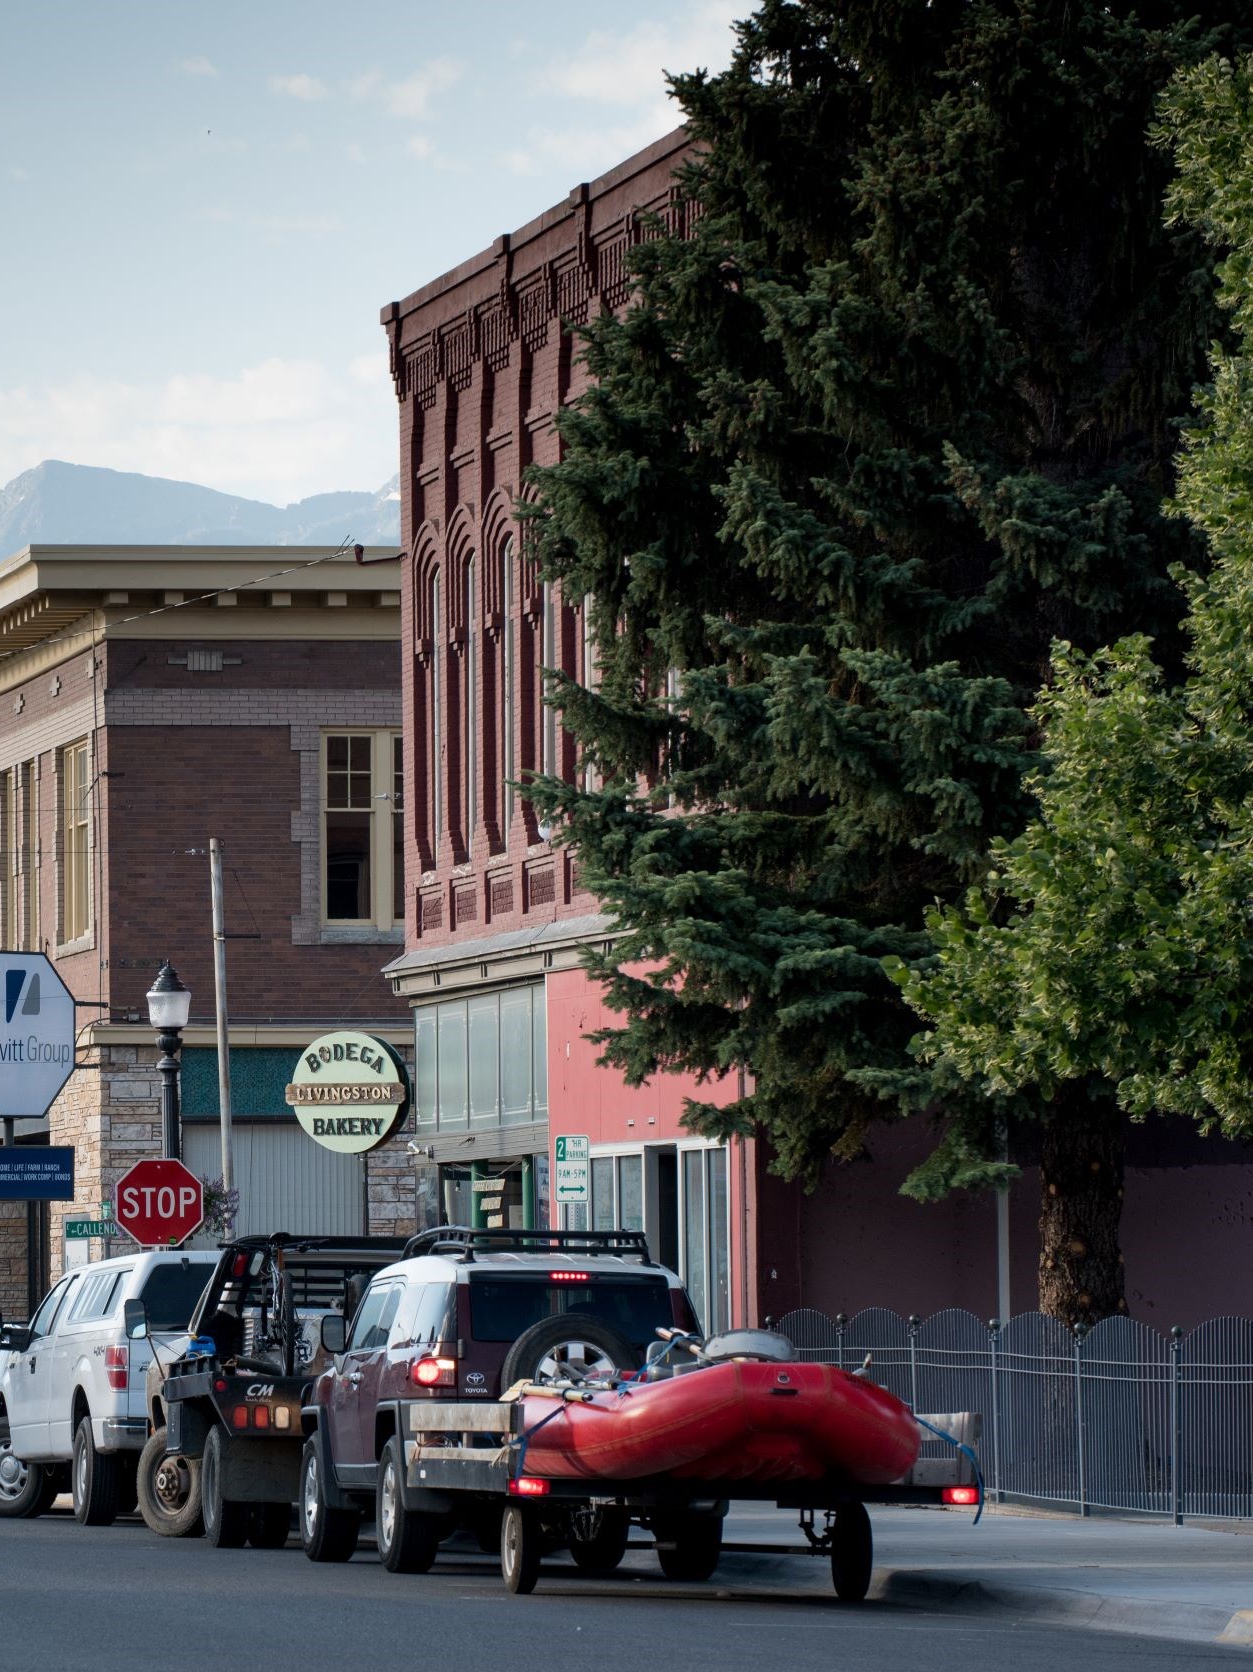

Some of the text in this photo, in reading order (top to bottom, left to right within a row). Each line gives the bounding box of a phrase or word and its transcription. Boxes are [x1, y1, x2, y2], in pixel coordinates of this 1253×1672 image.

[27, 1035, 71, 1068] Group
[304, 1043, 385, 1074] BODEGA
[296, 1086, 392, 1101] LIVINGSTON
[312, 1117, 384, 1137] BAKERY
[557, 1139, 582, 1158] 2 HR
[566, 1150, 587, 1159] PARKING
[14, 1163, 24, 1172] LIFE
[27, 1163, 41, 1172] FARM
[44, 1163, 60, 1172] RANCH
[122, 1187, 197, 1219] STOP
[76, 1222, 119, 1236] CALLEND
[247, 1384, 275, 1397] CM
